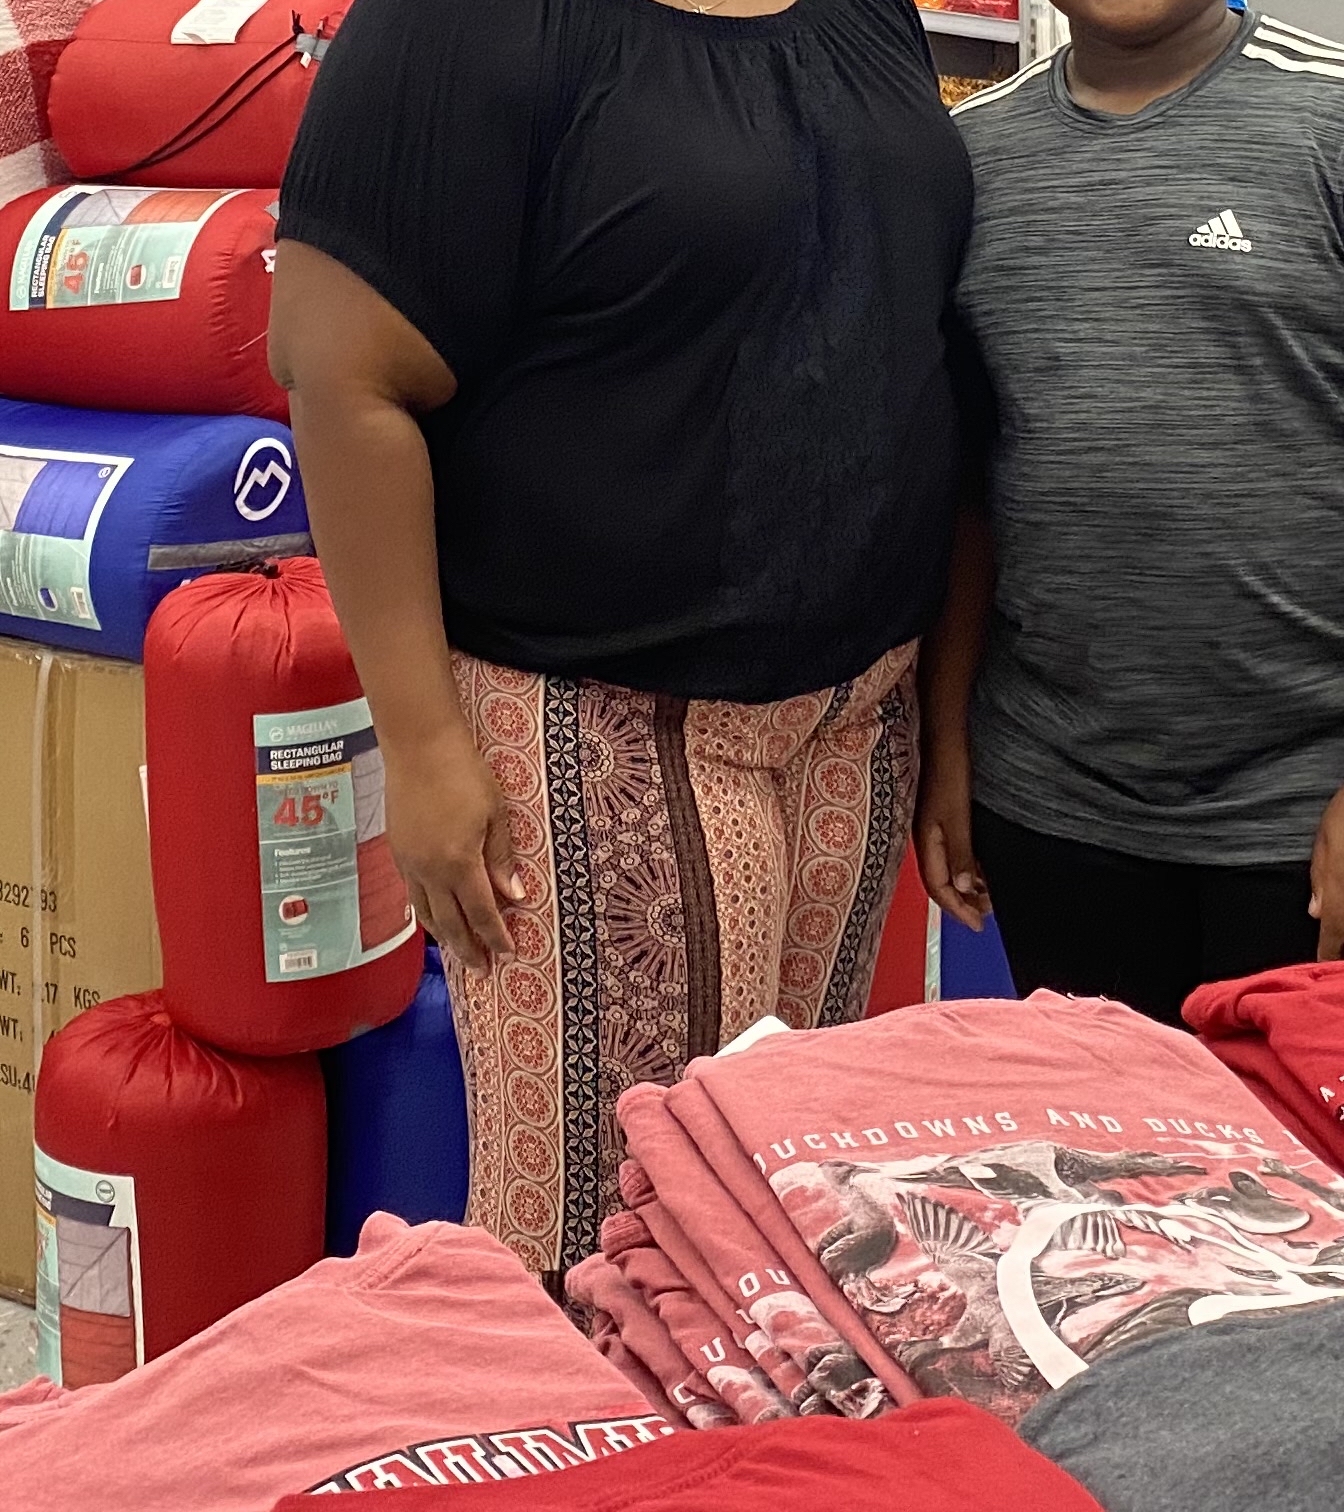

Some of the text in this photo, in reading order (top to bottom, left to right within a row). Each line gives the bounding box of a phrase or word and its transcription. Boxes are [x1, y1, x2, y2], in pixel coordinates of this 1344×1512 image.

[1188, 232, 1253, 253] adidas
[31, 234, 50, 298] RECTANGULAR
[37, 235, 56, 298] SLEEPING BAG
[286, 719, 338, 737] MAGELLAN
[270, 740, 345, 760] RECTANGULAR
[270, 751, 343, 771] SLEEPING BAG
[20, 926, 30, 948] 6
[49, 932, 77, 959] PCS
[38, 982, 59, 1005] .17
[73, 986, 101, 1009] KGS
[1045, 1106, 1123, 1133] AND
[1143, 1116, 1264, 1146] DUCKS
